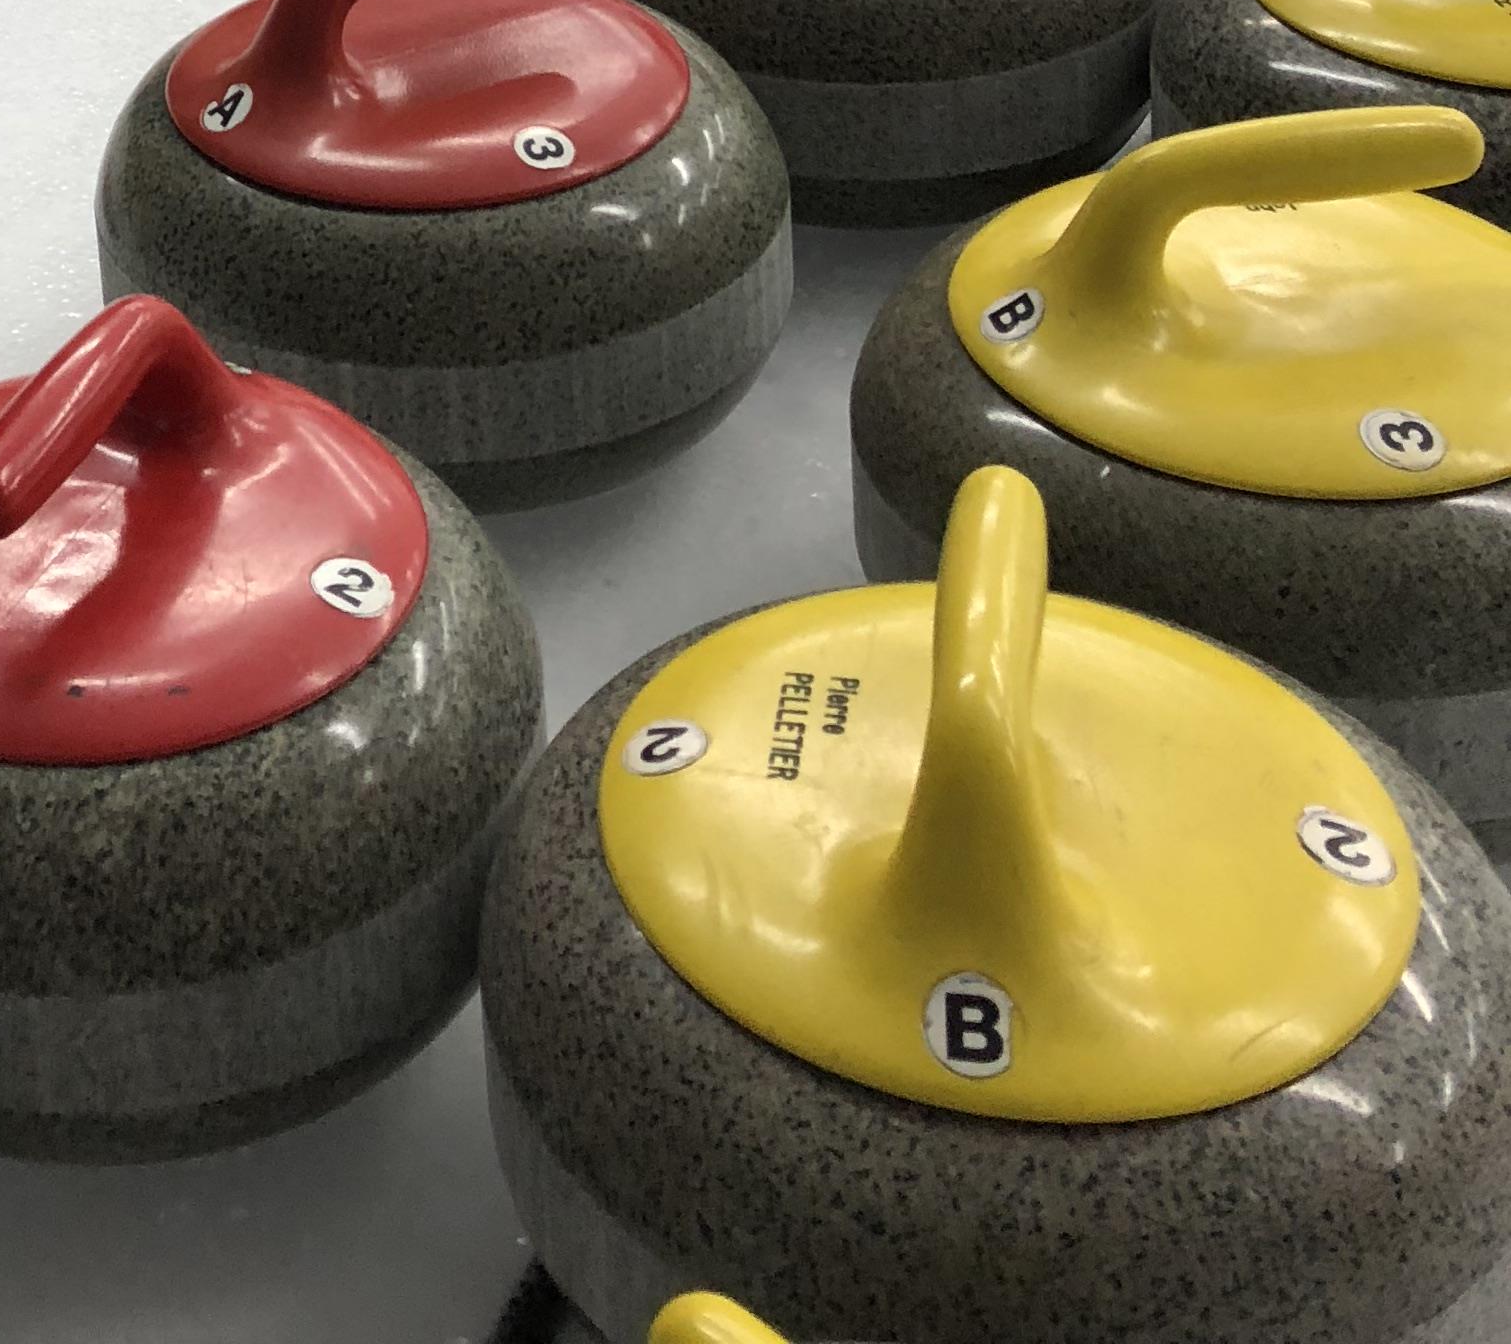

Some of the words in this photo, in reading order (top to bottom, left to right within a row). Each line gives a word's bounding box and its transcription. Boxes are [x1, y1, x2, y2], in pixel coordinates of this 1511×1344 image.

[207, 89, 245, 128] A
[523, 135, 565, 161] 3
[987, 291, 1037, 335] B
[1378, 419, 1435, 453] 3
[323, 566, 377, 609] 2
[766, 671, 815, 782] PELLETIER
[822, 675, 861, 736] Pierre
[639, 726, 689, 763] 2
[1315, 819, 1375, 872] 2
[943, 993, 1003, 1065] B
